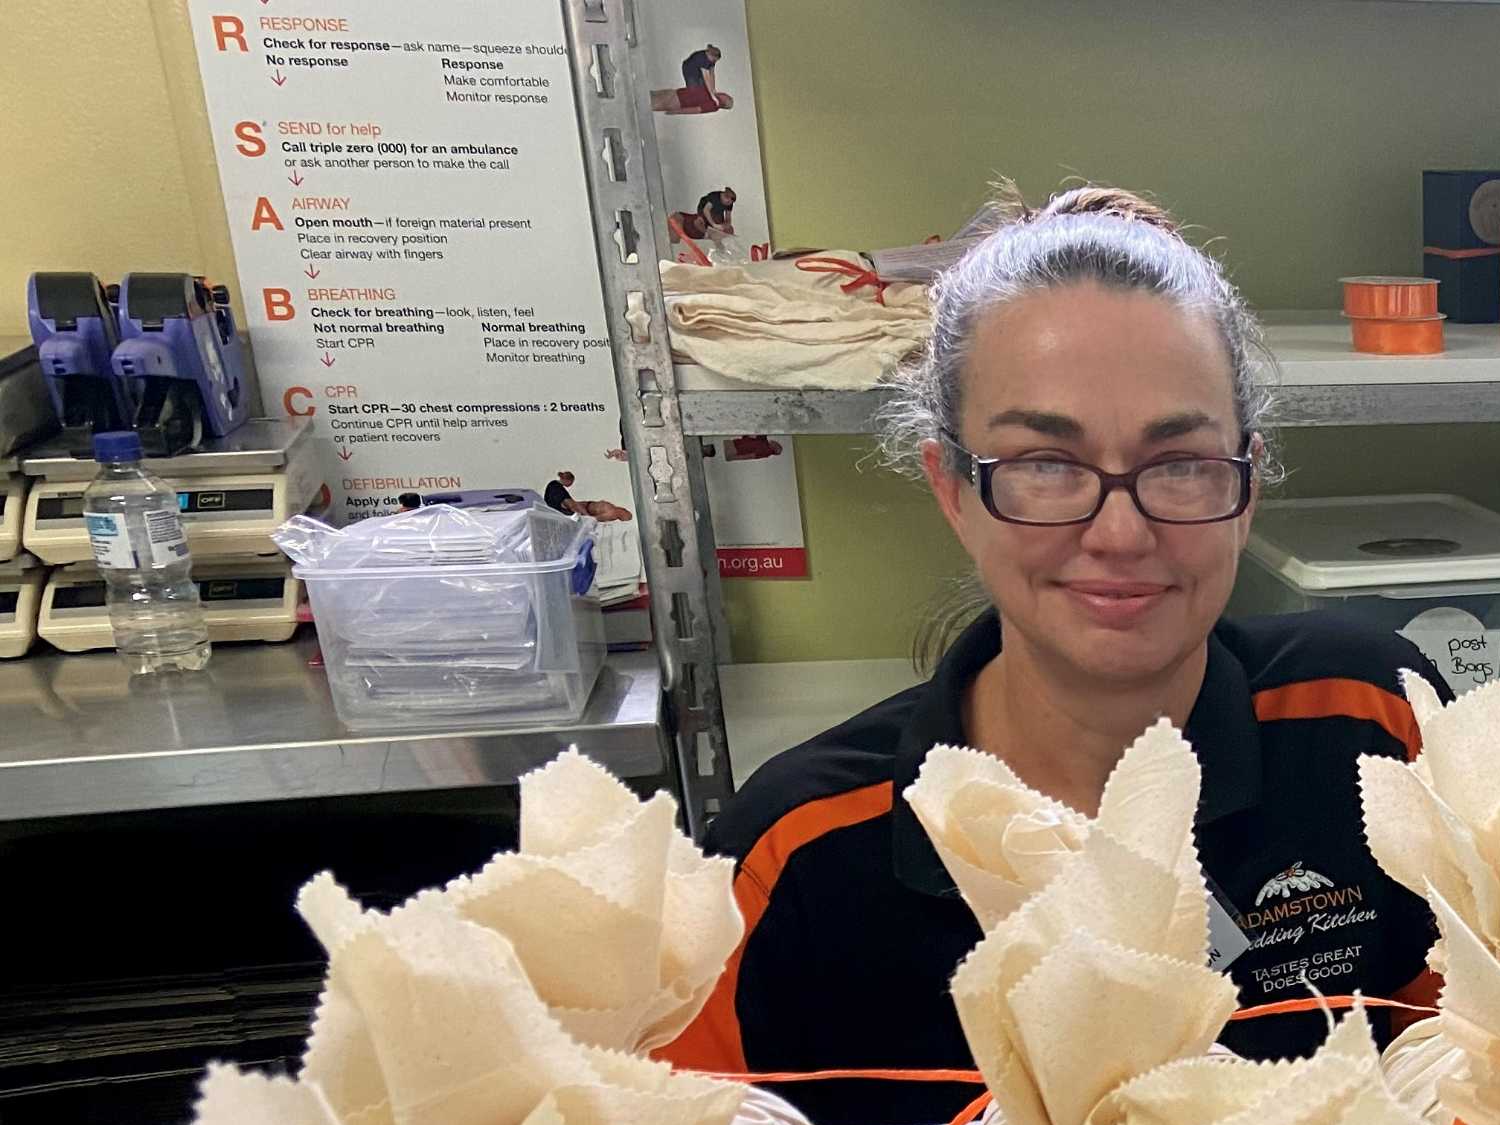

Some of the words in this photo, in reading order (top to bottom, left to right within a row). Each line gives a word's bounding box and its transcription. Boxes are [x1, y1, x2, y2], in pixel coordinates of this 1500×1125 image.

[259, 16, 349, 32] RESPONSE
[211, 15, 249, 52] R
[263, 37, 305, 50] Check
[309, 38, 327, 50] for
[525, 43, 568, 56] should
[266, 54, 285, 66] No
[289, 56, 349, 68] response
[441, 58, 504, 71] Response
[444, 75, 476, 86] Make
[480, 76, 550, 87] comfortable
[446, 91, 492, 102] Monitor
[495, 94, 549, 105] response
[278, 121, 322, 135] SEND
[327, 122, 346, 136] for
[350, 123, 381, 140] help
[234, 120, 267, 158] S
[281, 141, 306, 153] Call
[310, 142, 342, 155] triple
[346, 144, 374, 153] zero
[377, 143, 407, 155] (000)
[410, 143, 428, 154] for
[432, 145, 447, 154] an
[450, 144, 518, 155] ambulance
[284, 158, 296, 167] or
[300, 157, 321, 167] ask
[325, 157, 370, 168] another
[374, 159, 414, 170] person
[418, 158, 429, 168] to
[433, 158, 465, 168] make
[468, 159, 486, 169] the
[490, 159, 510, 170] call
[291, 197, 351, 210] AIRWAY
[251, 196, 285, 231] A
[295, 217, 330, 229] Open
[396, 217, 437, 230] foreign
[440, 218, 485, 228] material
[488, 219, 532, 229] present
[297, 232, 331, 243] Place
[334, 232, 344, 243] in
[348, 235, 398, 246] recovery
[402, 233, 448, 245] position
[300, 248, 332, 259] Clear
[335, 249, 373, 261] airway
[376, 249, 401, 259] with
[404, 249, 444, 261] fingers
[307, 288, 396, 301] BREATHING
[263, 287, 296, 321] B
[311, 307, 350, 318] Check
[354, 307, 372, 318] for
[514, 307, 535, 317] feel
[314, 323, 337, 333] Not
[340, 323, 383, 333] normal
[386, 322, 445, 334] breathing
[481, 322, 526, 333] Normal
[528, 322, 586, 334] breathing
[316, 338, 345, 349] Start
[347, 338, 375, 349] CPR
[484, 337, 515, 348] Place
[518, 338, 529, 348] in
[532, 339, 580, 350] recovery
[583, 338, 611, 350] posit
[486, 352, 530, 363] Monitor
[533, 352, 585, 365] breathing
[324, 385, 359, 398] CPR
[283, 386, 317, 417] C
[328, 404, 359, 414] Start
[419, 403, 453, 413] chest
[456, 402, 541, 415] compressions
[550, 402, 558, 412] 2
[560, 402, 606, 412] breaths
[331, 418, 384, 429] Continue
[386, 418, 413, 429] CPR
[416, 418, 440, 428] until
[443, 418, 468, 429] help
[471, 418, 509, 428] arrives
[333, 434, 345, 443] or
[348, 432, 388, 444] patient
[391, 432, 441, 442] recovers
[342, 476, 462, 490] DEFIBRILLATION
[346, 495, 380, 507] Apply
[1451, 656, 1494, 684] Bags
[1308, 907, 1378, 932] Kitchen
[1252, 957, 1310, 982] TASTES
[1313, 946, 1363, 966] GREAT
[1263, 974, 1306, 993] DOES
[1309, 962, 1354, 981] GOOD
